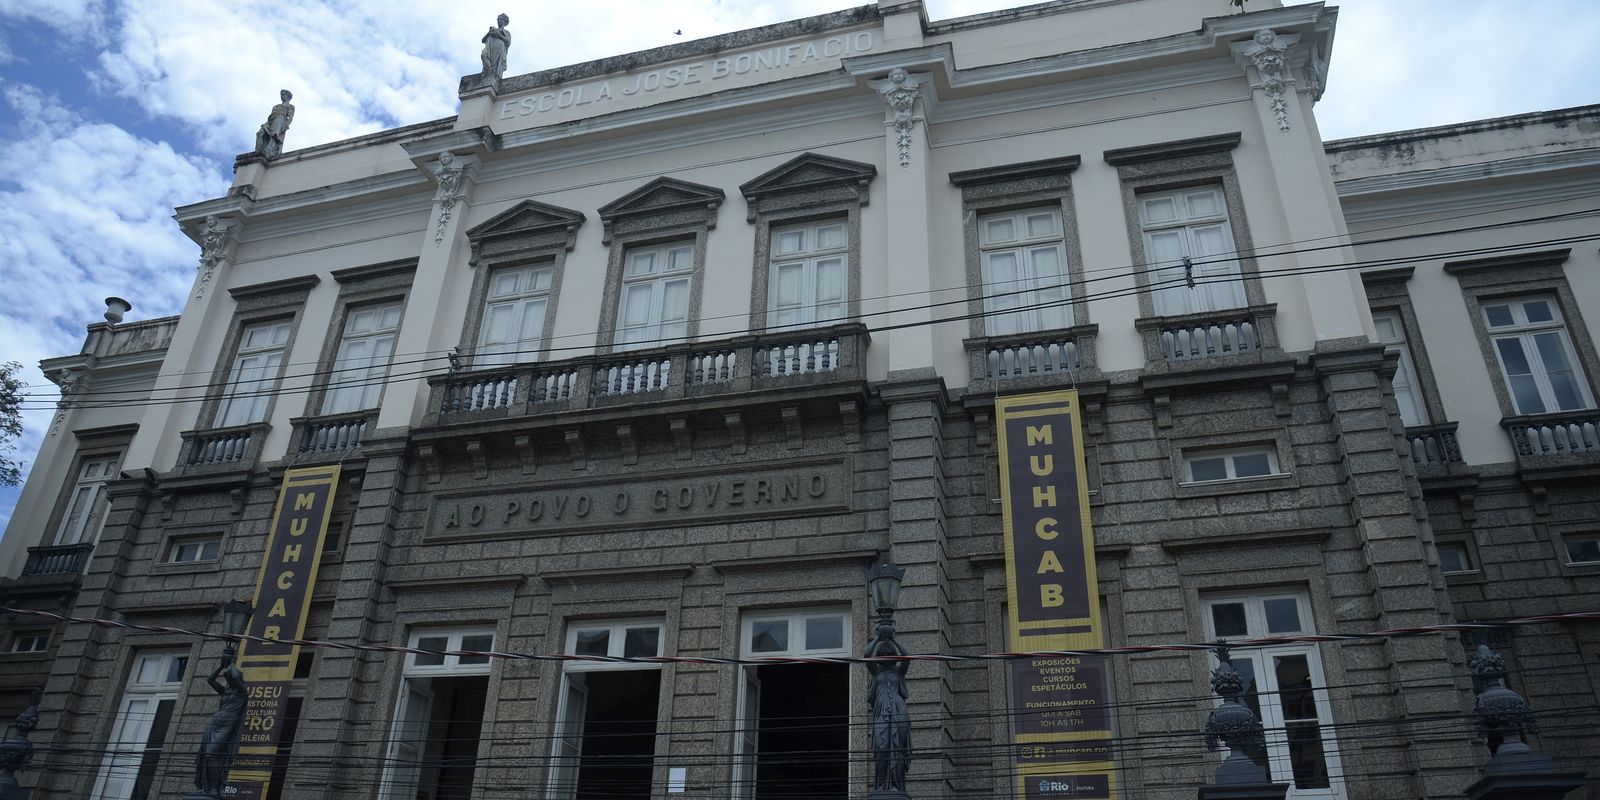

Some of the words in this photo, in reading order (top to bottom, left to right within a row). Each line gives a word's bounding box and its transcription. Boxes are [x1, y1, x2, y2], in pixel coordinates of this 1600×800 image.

[500, 81, 612, 121] ESCOLA
[623, 62, 704, 96] JOSE
[712, 31, 874, 80] BONIFACIO
[446, 503, 486, 528] AO
[504, 495, 592, 524] POVO
[614, 491, 630, 516] O
[652, 474, 827, 512] GOVERNO
[1026, 424, 1065, 608] MUHCAB
[262, 492, 316, 645] MUHCAB
[1032, 658, 1081, 667] EXPOSIÇÕES
[1040, 667, 1076, 675] EVENTOS
[1043, 675, 1075, 683] CURSOS
[246, 686, 282, 698] USEU
[1031, 682, 1087, 692] ESPETÁCULOS
[1025, 699, 1096, 709] FUNCIONAMENTO
[1070, 718, 1084, 726] 17H
[241, 734, 271, 742] SILEIRA
[224, 785, 238, 794] Rio
[1050, 781, 1069, 791] Rio
